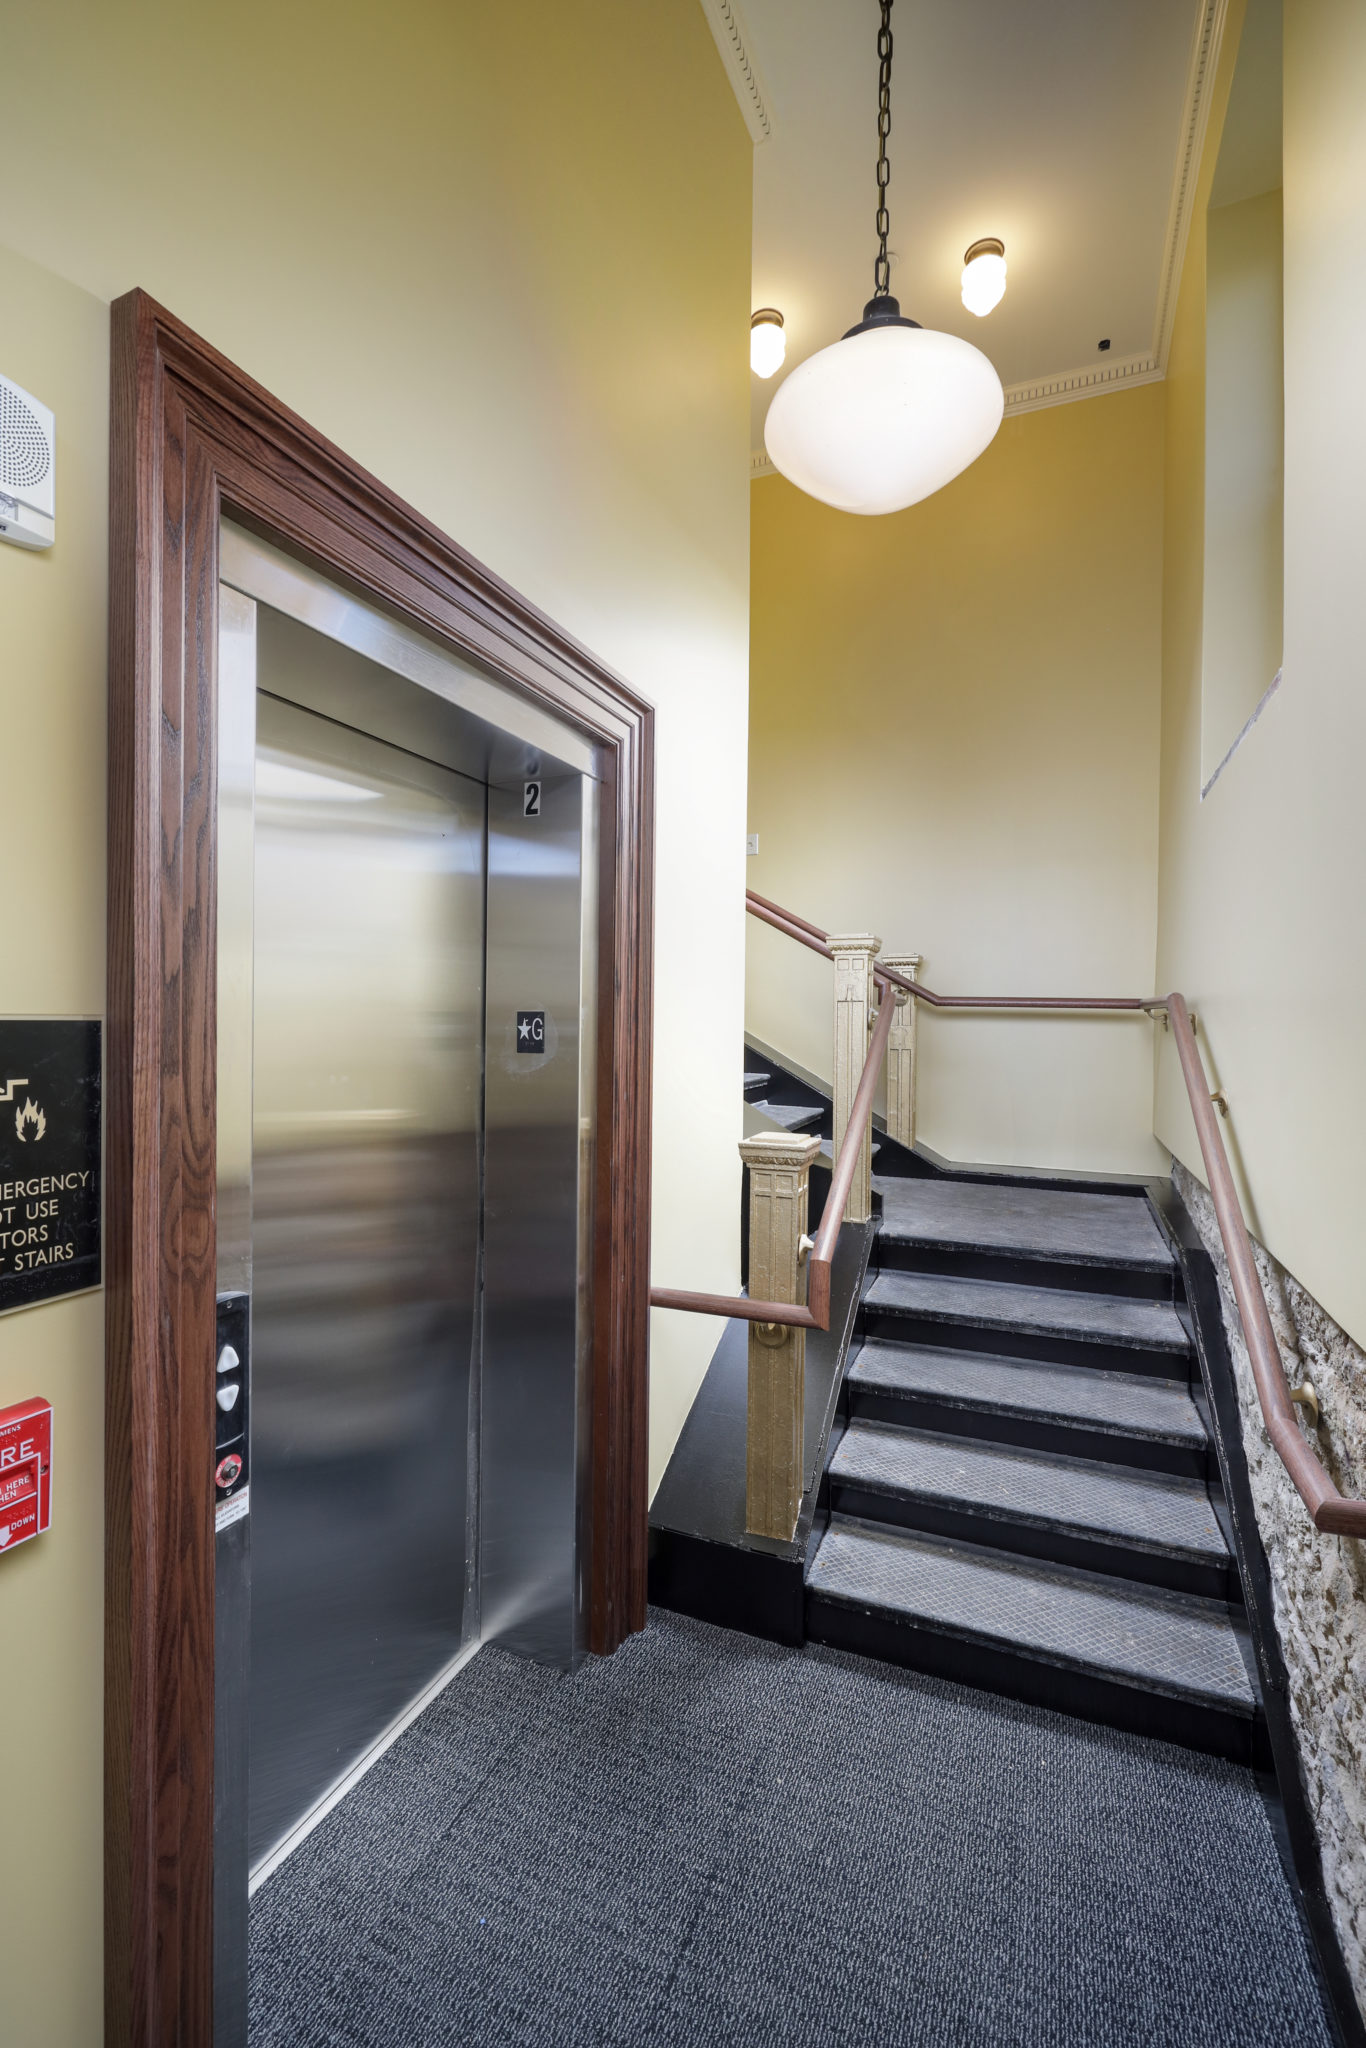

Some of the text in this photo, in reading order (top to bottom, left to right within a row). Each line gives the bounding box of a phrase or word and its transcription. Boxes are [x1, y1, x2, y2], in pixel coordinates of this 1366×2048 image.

[526, 783, 539, 815] 2
[532, 1017, 543, 1040] G
[0, 1170, 89, 1201] ERGENCY
[26, 1199, 59, 1220] USE
[0, 1224, 48, 1249] TORS
[14, 1242, 74, 1271] STAIRS
[6, 1475, 30, 1492] HERE
[10, 1513, 35, 1531] DOWN
